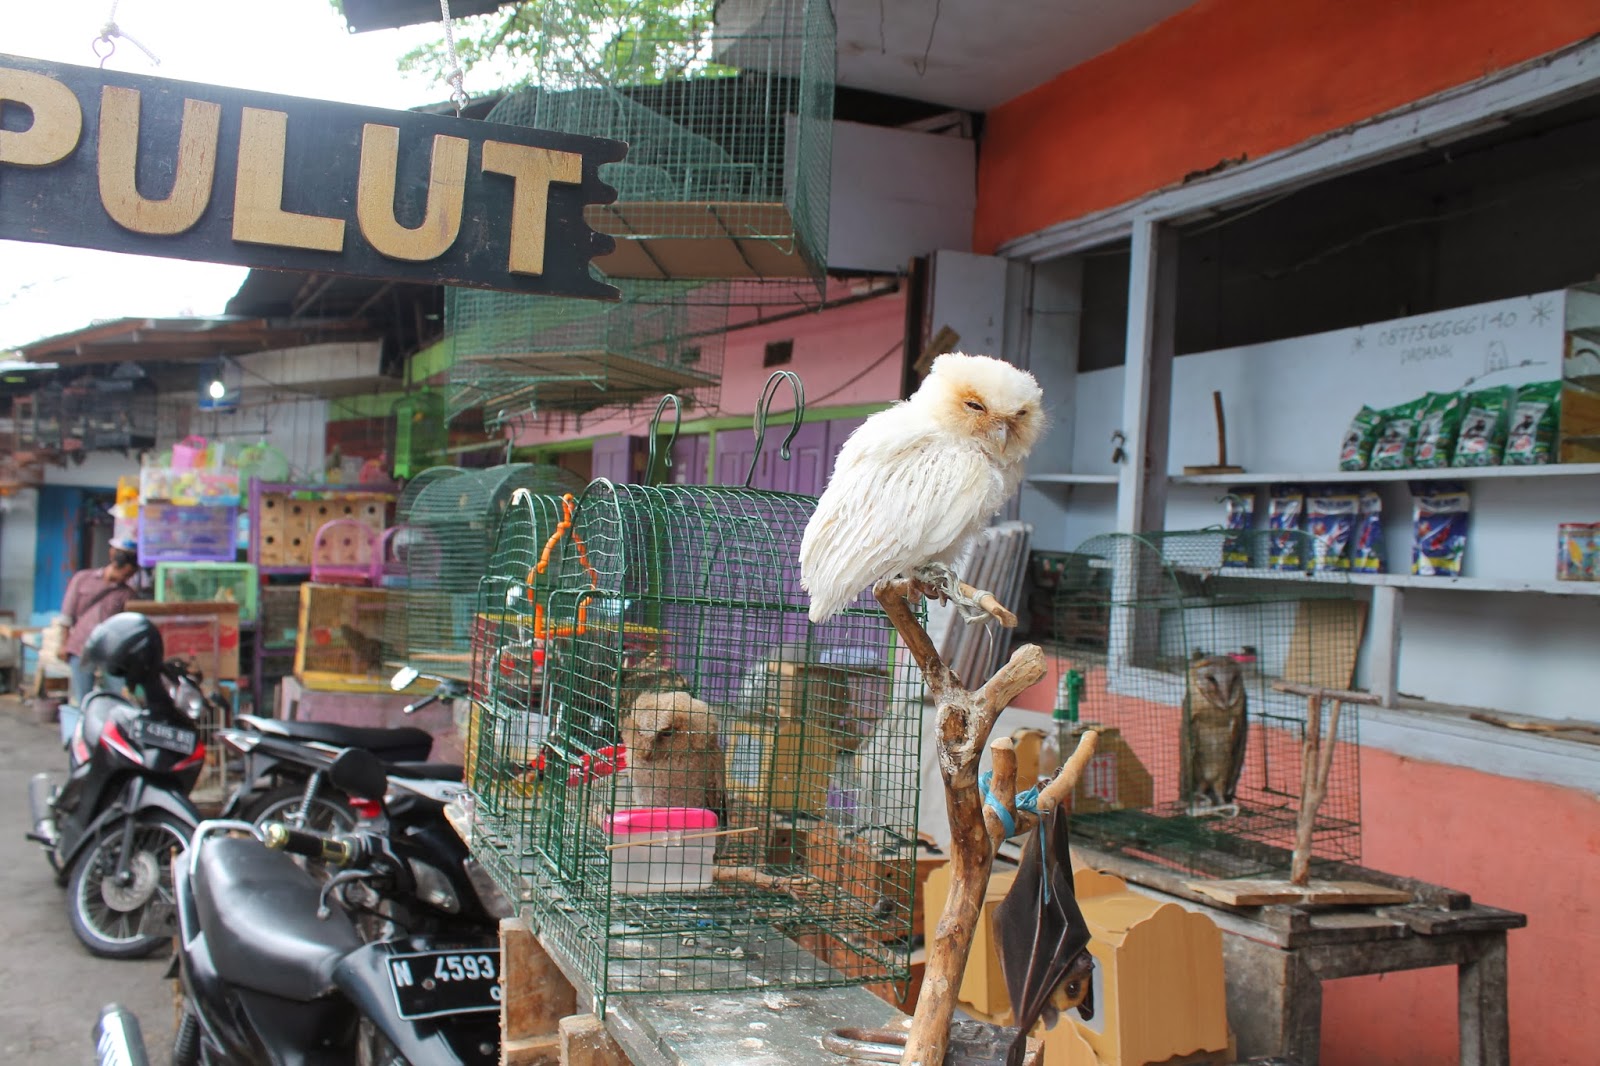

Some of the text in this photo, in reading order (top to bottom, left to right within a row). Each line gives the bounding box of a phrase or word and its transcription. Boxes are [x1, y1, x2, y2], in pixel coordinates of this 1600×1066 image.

[0, 67, 583, 276] PULUT
[392, 955, 495, 987] N 4593
